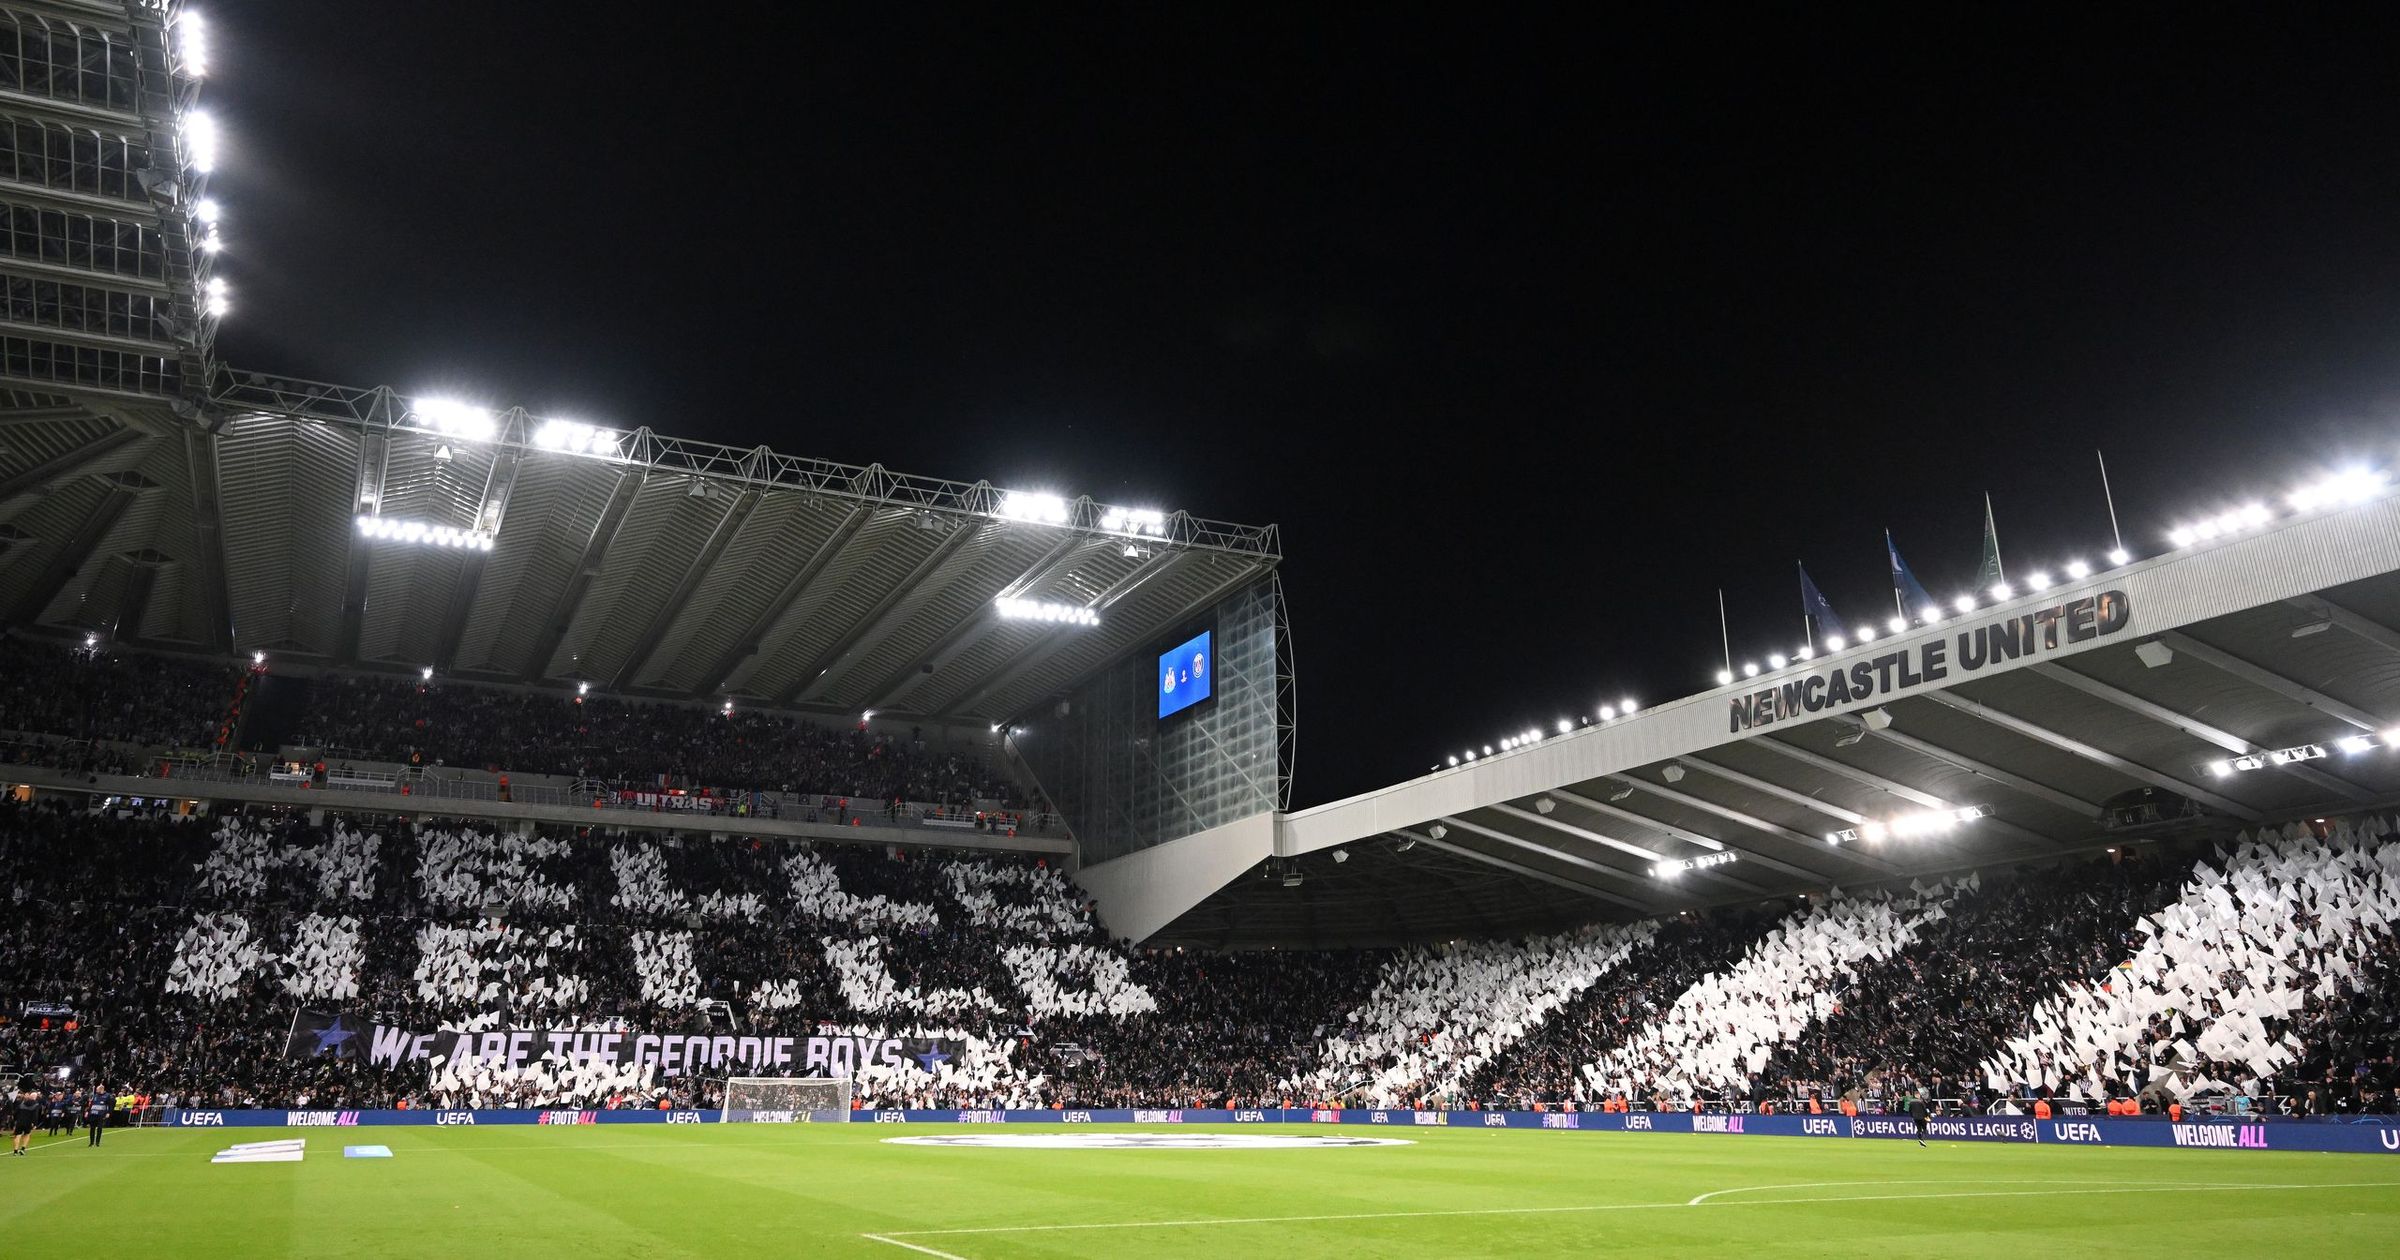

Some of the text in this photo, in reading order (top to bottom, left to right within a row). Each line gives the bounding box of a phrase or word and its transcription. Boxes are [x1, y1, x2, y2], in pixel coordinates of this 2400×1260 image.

[1729, 589, 2129, 732] NEWCASTLE UNITED
[637, 793, 712, 810] ULTRAS
[370, 1025, 902, 1078] WE ARE THE GEORDIE BOYS
[181, 1111, 224, 1126] UEFA
[287, 1111, 360, 1126] WELCOME ALL
[436, 1111, 475, 1125] UEFA
[537, 1111, 598, 1126] #FOOTBALL
[666, 1111, 701, 1124] UEFA
[753, 1111, 793, 1124] WELCOME
[874, 1111, 906, 1123] UEFA
[957, 1110, 1006, 1124] #FOOTBALL
[1062, 1111, 1092, 1123] UEFA
[1133, 1110, 1184, 1123] WELCOME ALL
[1234, 1110, 1265, 1122] UEFA
[1371, 1111, 1389, 1123] UEFA
[1414, 1111, 1448, 1126] WELCOME ALL
[1484, 1113, 1507, 1126] UEFA
[1542, 1113, 1580, 1129] #FOOTBALL
[1625, 1115, 1652, 1130] UEFA
[1692, 1115, 1745, 1133] WELCOME ALL
[1803, 1118, 1838, 1135] UEFA
[1867, 1121, 1896, 1135] UEFA
[1970, 1122, 2018, 1138] LEAGUE
[2054, 1123, 2102, 1142] UEFA
[2171, 1124, 2268, 1148] WELCOME ALL
